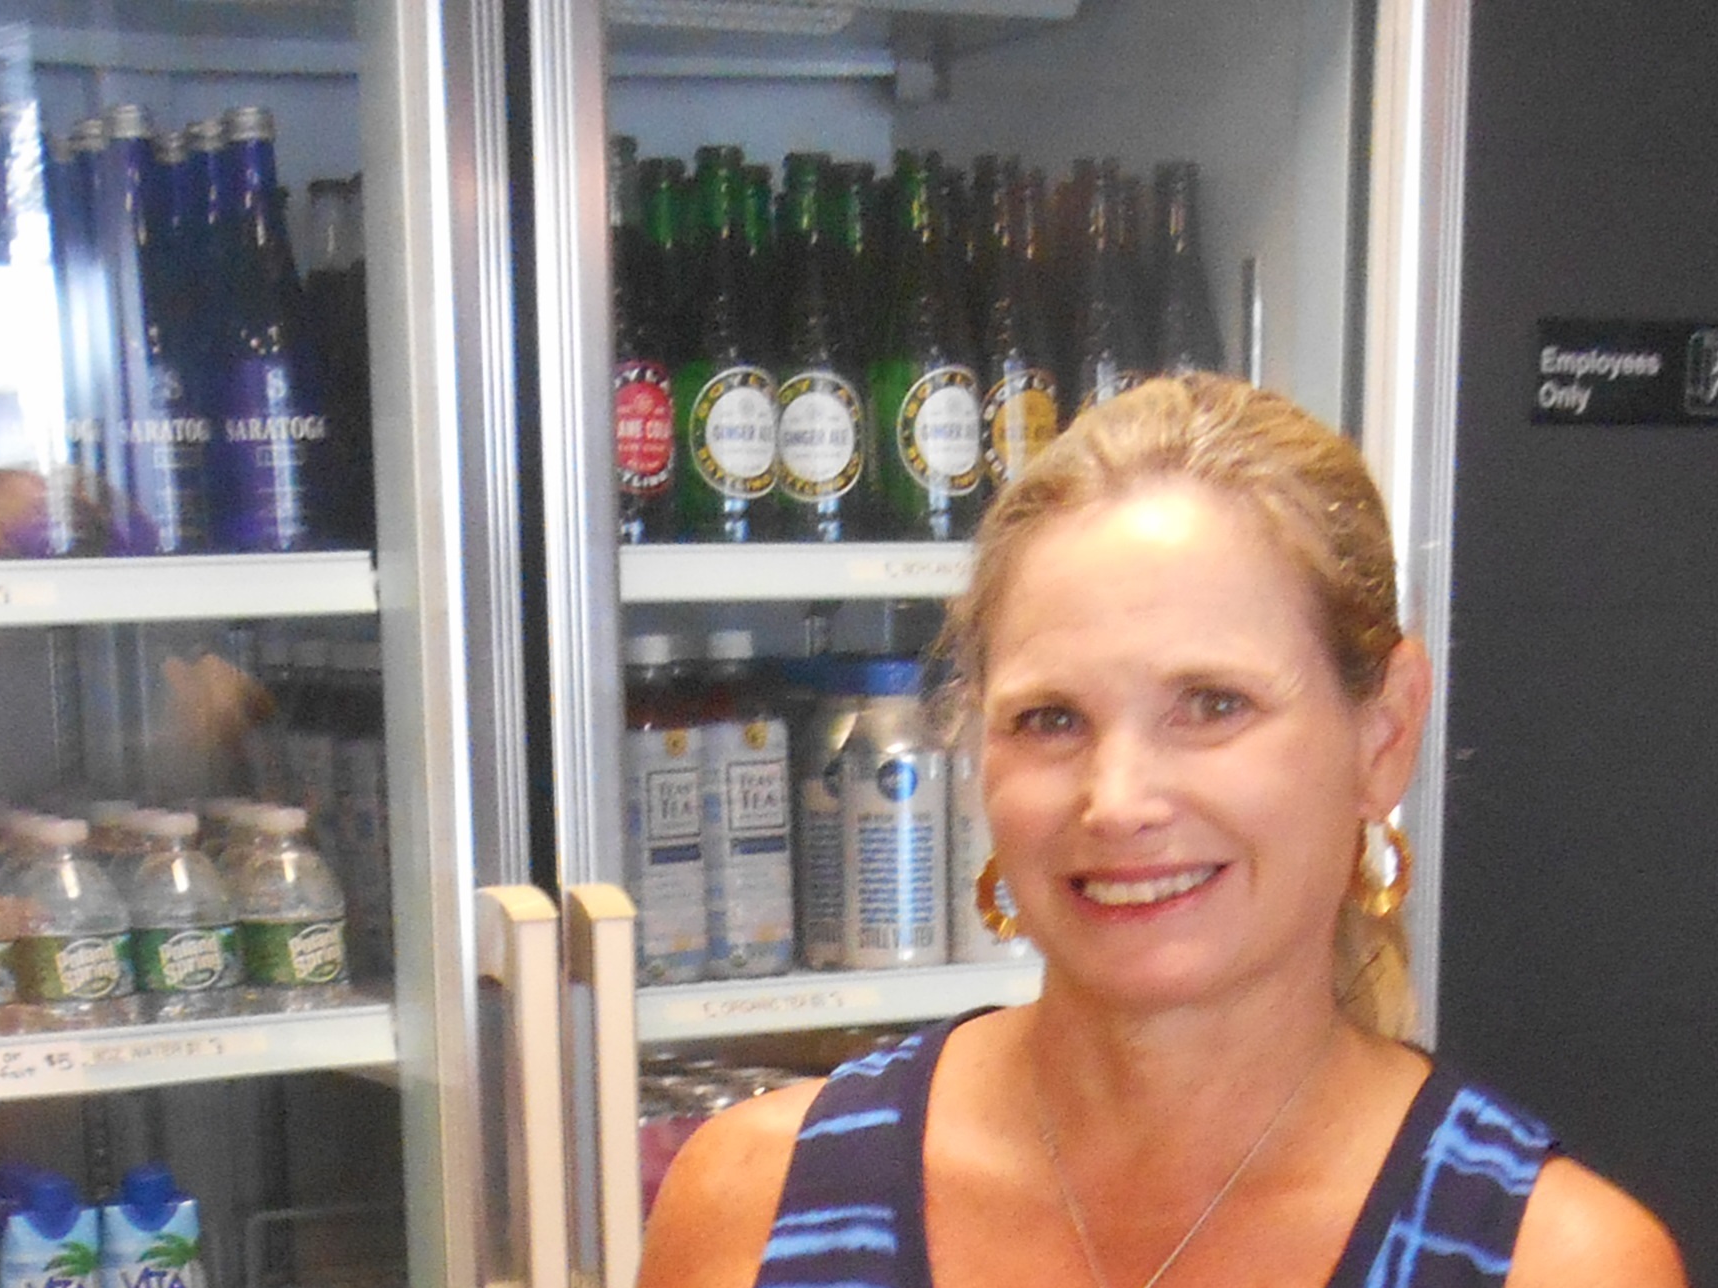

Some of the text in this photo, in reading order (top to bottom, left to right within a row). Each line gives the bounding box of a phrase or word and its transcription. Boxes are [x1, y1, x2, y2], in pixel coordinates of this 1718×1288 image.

[1540, 345, 1662, 380] Employees
[1538, 379, 1593, 415] Only
[2, 1051, 22, 1064] or
[43, 1052, 75, 1071] $5
